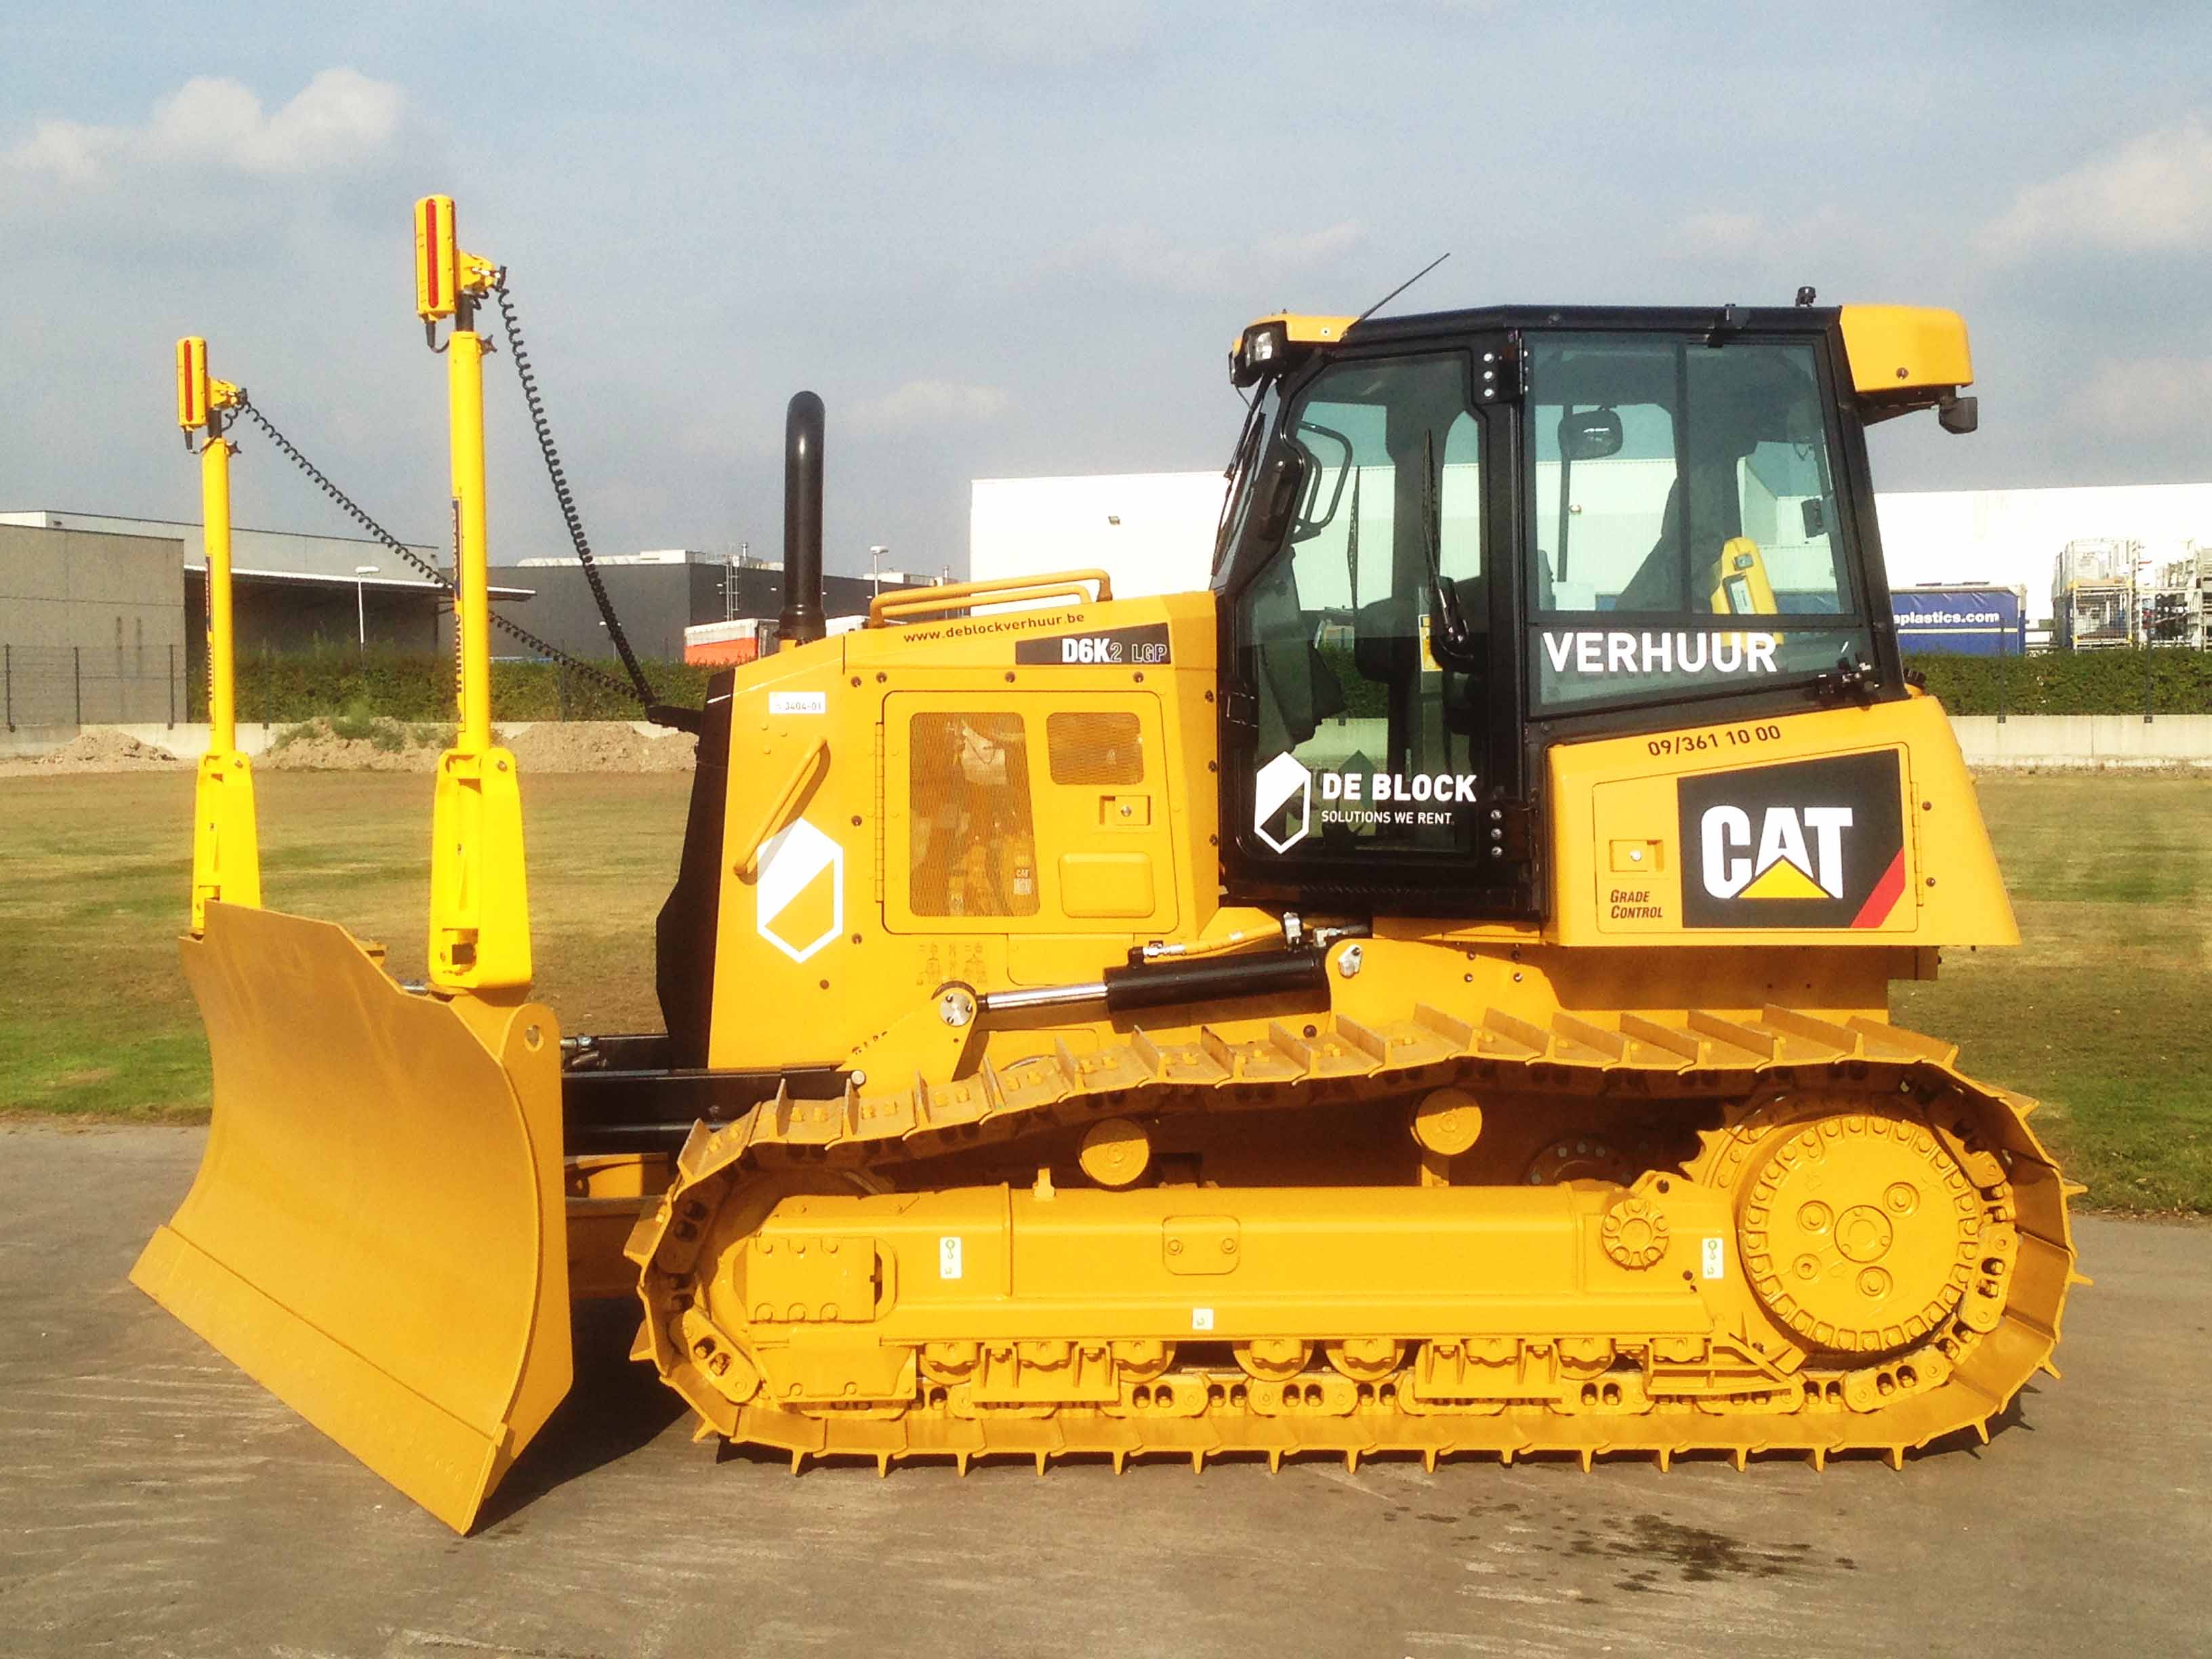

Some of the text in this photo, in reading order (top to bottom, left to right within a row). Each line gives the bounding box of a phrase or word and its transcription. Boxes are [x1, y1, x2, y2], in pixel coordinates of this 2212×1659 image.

[903, 613, 1085, 643] www.deblockverhuur.be
[1132, 643, 1168, 662] LGP
[1542, 632, 1778, 672] VERHUUR
[1648, 725, 1781, 756] 09/361 10 00
[1322, 773, 1477, 802] DE BLOCK
[1322, 811, 1390, 824] SOLUTIONS
[1394, 812, 1414, 824] WE
[1701, 805, 1853, 899] CAT
[1610, 889, 1650, 903] GRADE
[1611, 905, 1663, 918] CONTROL
